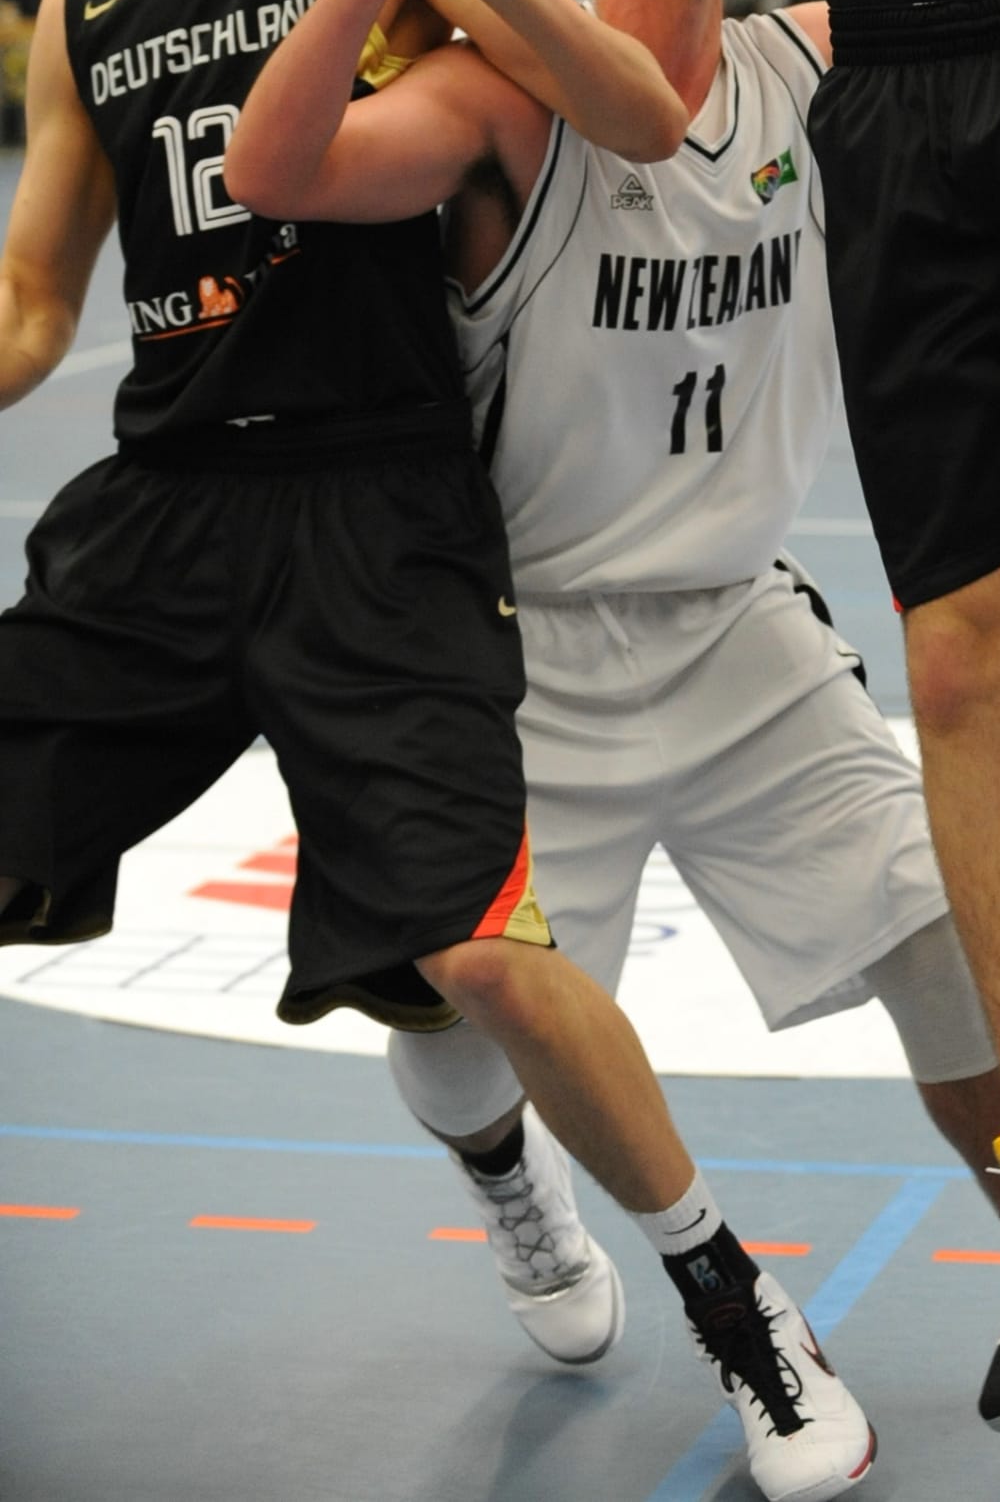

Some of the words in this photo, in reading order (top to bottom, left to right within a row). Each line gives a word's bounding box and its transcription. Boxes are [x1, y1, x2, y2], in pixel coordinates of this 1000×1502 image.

[152, 104, 252, 237] 12
[611, 194, 654, 211] PEAK
[130, 291, 193, 336] ING
[592, 253, 687, 332] NEW
[670, 364, 726, 455] 11
